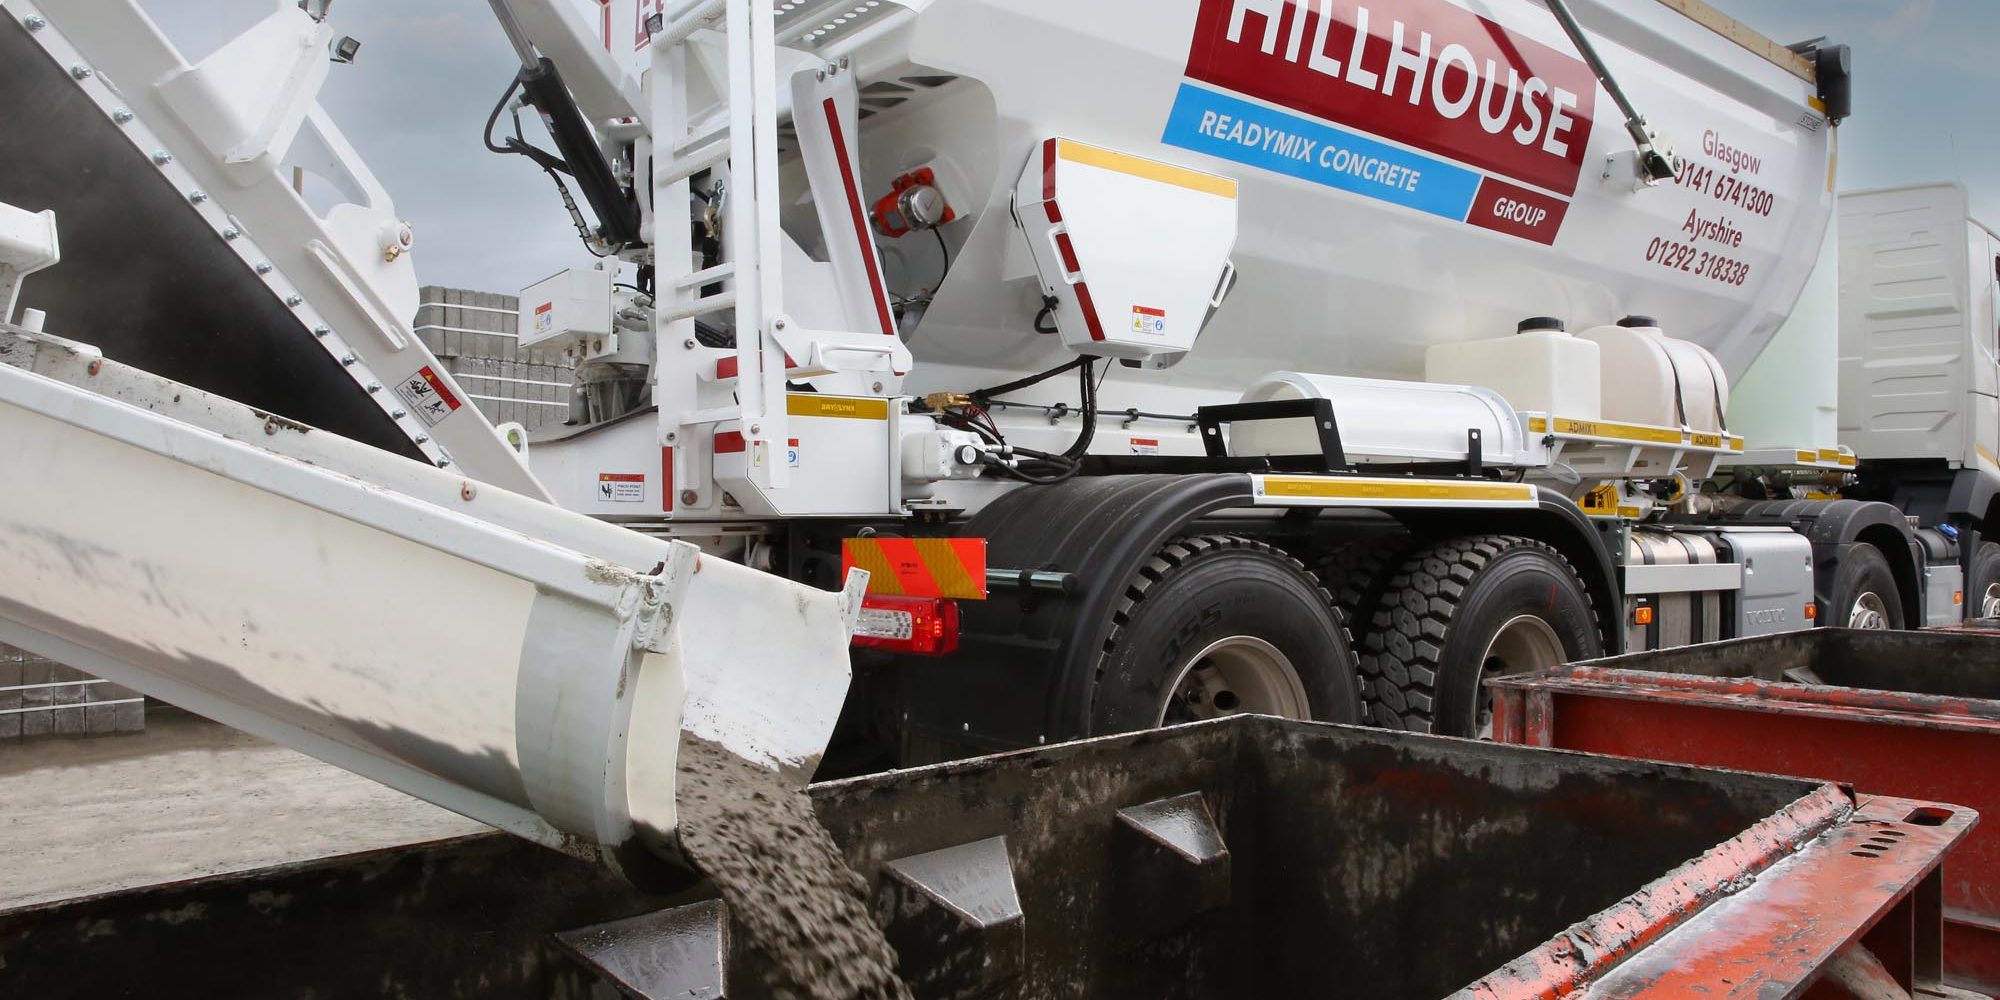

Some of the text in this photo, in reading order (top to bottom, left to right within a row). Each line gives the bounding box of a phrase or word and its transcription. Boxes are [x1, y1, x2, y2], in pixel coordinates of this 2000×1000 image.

[1226, 0, 1577, 158] HILLHOUSE
[1198, 110, 1421, 193] READYMIX CONCRETE
[1702, 129, 1761, 175] Glasgow
[1492, 196, 1546, 228] GROUP
[1714, 174, 1774, 217] 6741300
[1682, 208, 1743, 249] Ayrshire
[1645, 236, 1749, 287] 01292 318338
[1568, 422, 1592, 435] ADMIX
[1593, 424, 1597, 435] 1
